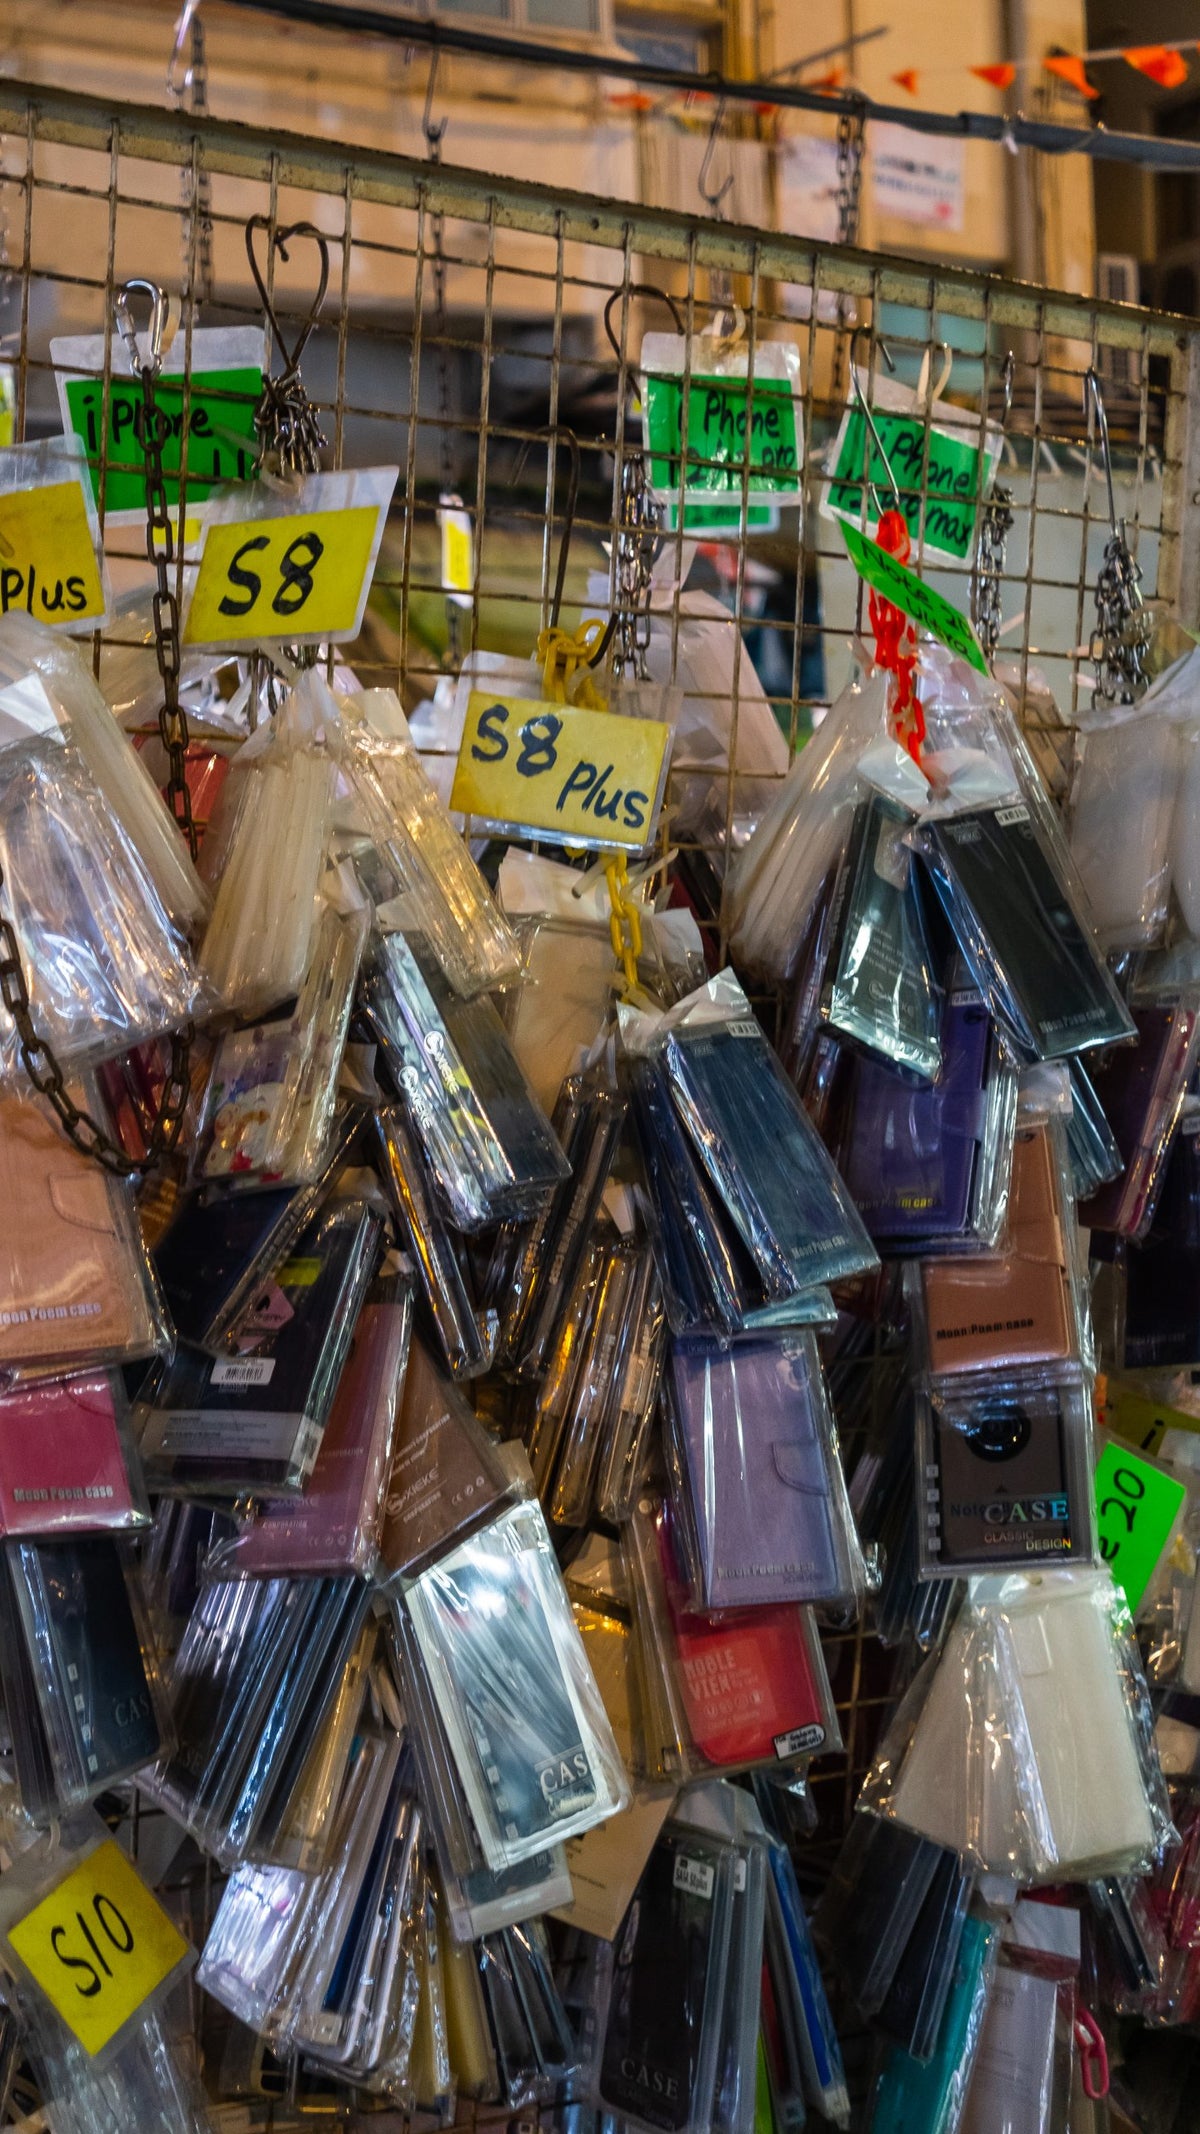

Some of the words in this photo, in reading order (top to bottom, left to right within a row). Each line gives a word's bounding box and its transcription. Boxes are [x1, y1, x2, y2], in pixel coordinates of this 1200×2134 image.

[925, 505, 972, 548] max
[1, 564, 87, 616] Plus
[218, 531, 325, 616] S8
[471, 704, 564, 778] S8
[556, 759, 650, 829] Plus
[984, 1499, 1069, 1525] CASE
[1100, 1467, 1146, 1533] 20
[983, 1529, 1035, 1545] CLASSIC
[1025, 1537, 1073, 1552] DESIGN
[51, 1892, 135, 1998] S10
[621, 2056, 680, 2101] CASE
